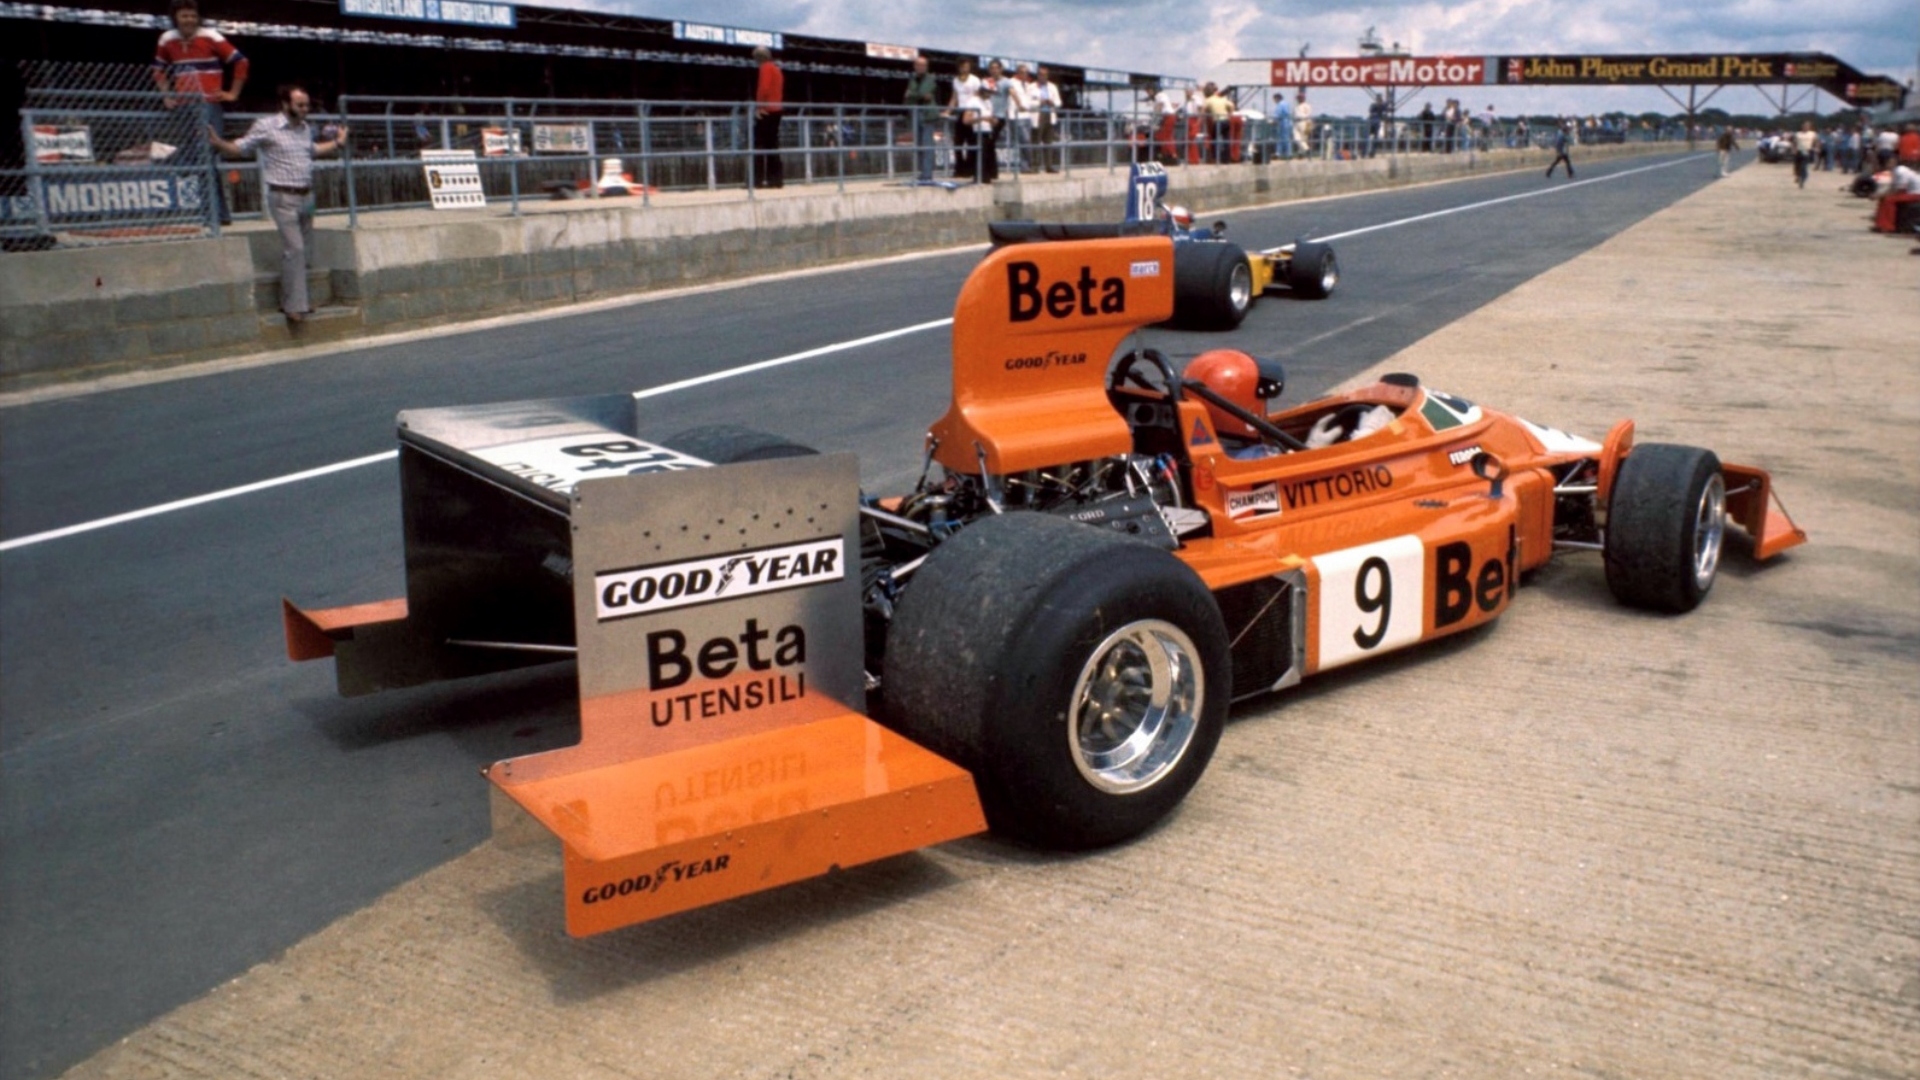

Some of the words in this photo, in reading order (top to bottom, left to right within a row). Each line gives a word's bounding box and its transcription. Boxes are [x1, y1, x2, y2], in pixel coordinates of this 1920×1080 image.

[1286, 61, 1373, 83] Motor
[1389, 59, 1481, 82] Motor
[1524, 57, 1575, 78] John
[1580, 58, 1645, 81] Player
[1649, 56, 1718, 78] Grand
[1721, 56, 1773, 78] Prix
[49, 179, 171, 214] MORRIS
[1136, 182, 1157, 221] 18
[1006, 260, 1126, 323] Beta
[1229, 490, 1276, 511] CHAMPION
[1283, 464, 1393, 510] VITTORIO
[1434, 523, 1517, 629] Bet
[1352, 556, 1392, 650] 9
[646, 618, 805, 692] Beta
[651, 672, 805, 727] UTENSILI
